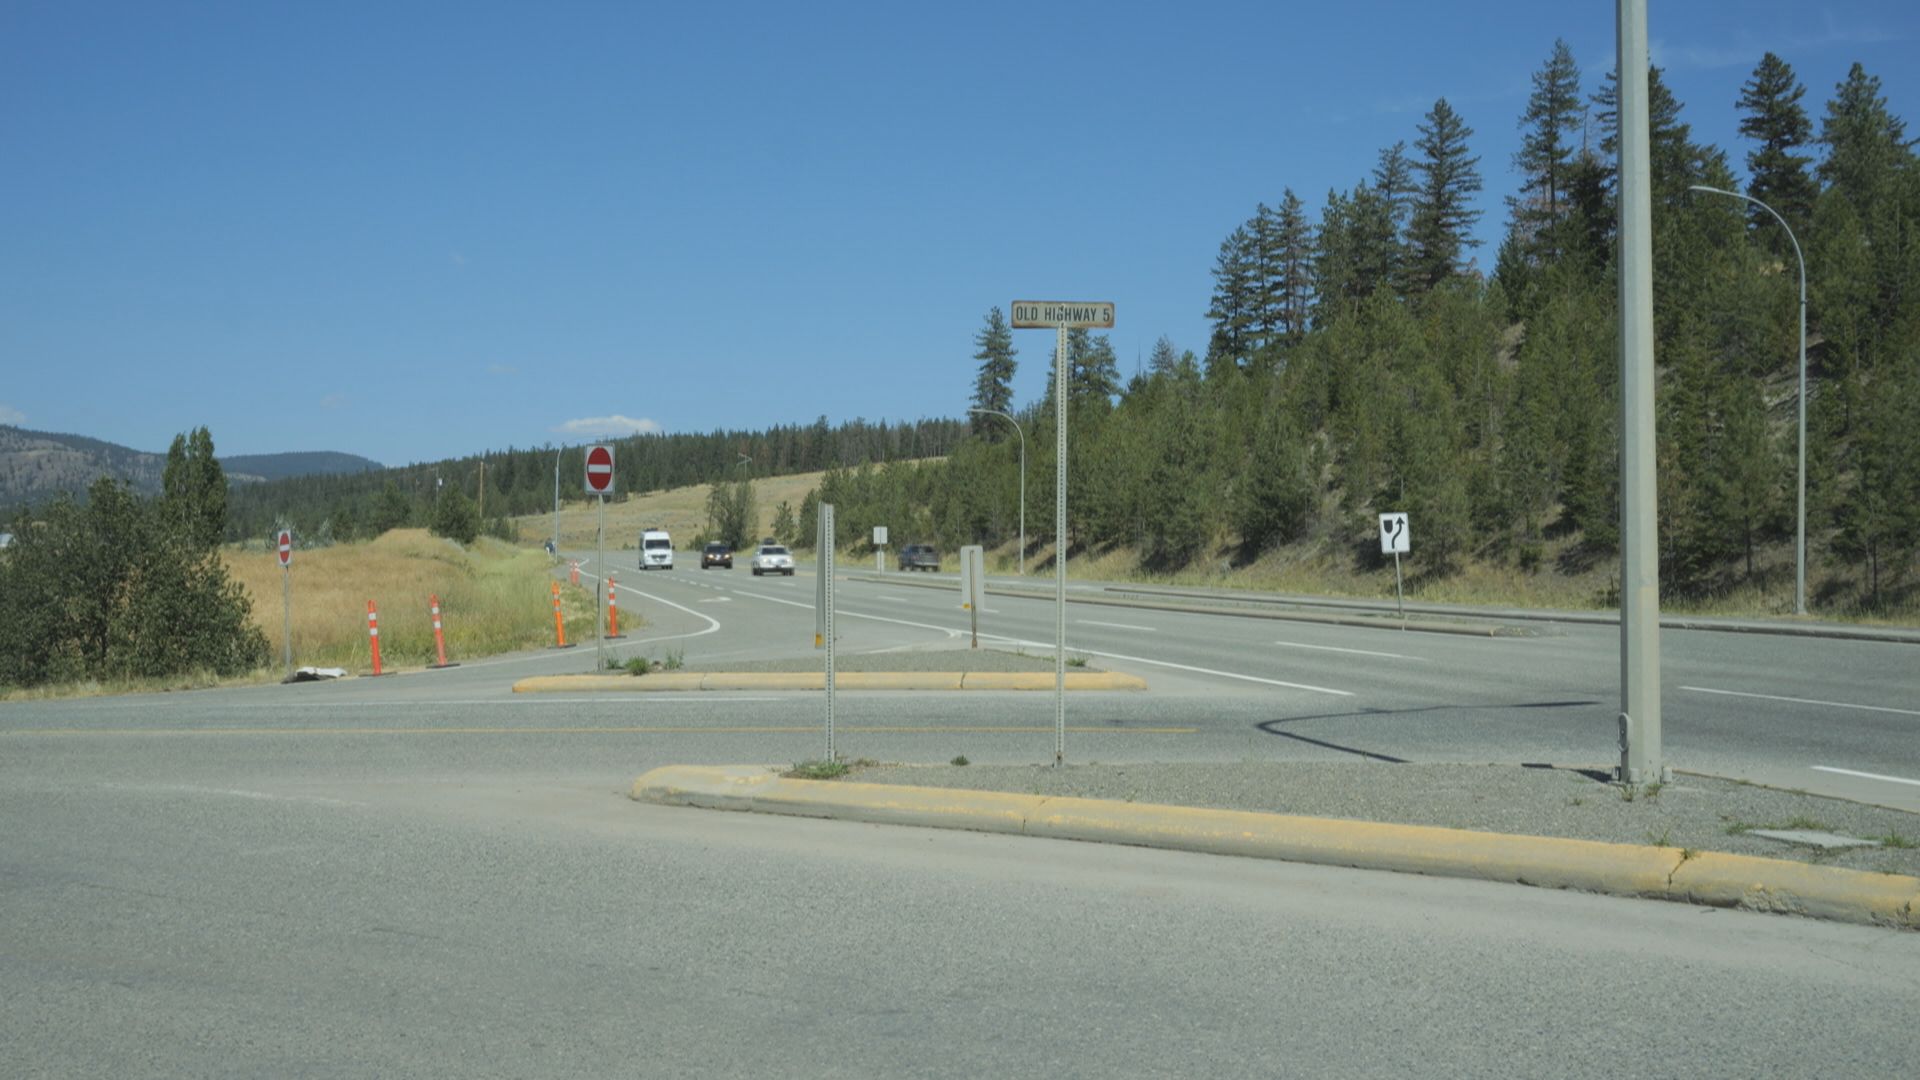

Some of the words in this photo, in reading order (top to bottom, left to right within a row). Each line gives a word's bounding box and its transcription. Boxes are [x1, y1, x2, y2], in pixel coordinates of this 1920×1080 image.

[1016, 306, 1038, 320] OLD
[1044, 307, 1097, 321] HIGHWAY
[1103, 309, 1110, 322] 5
